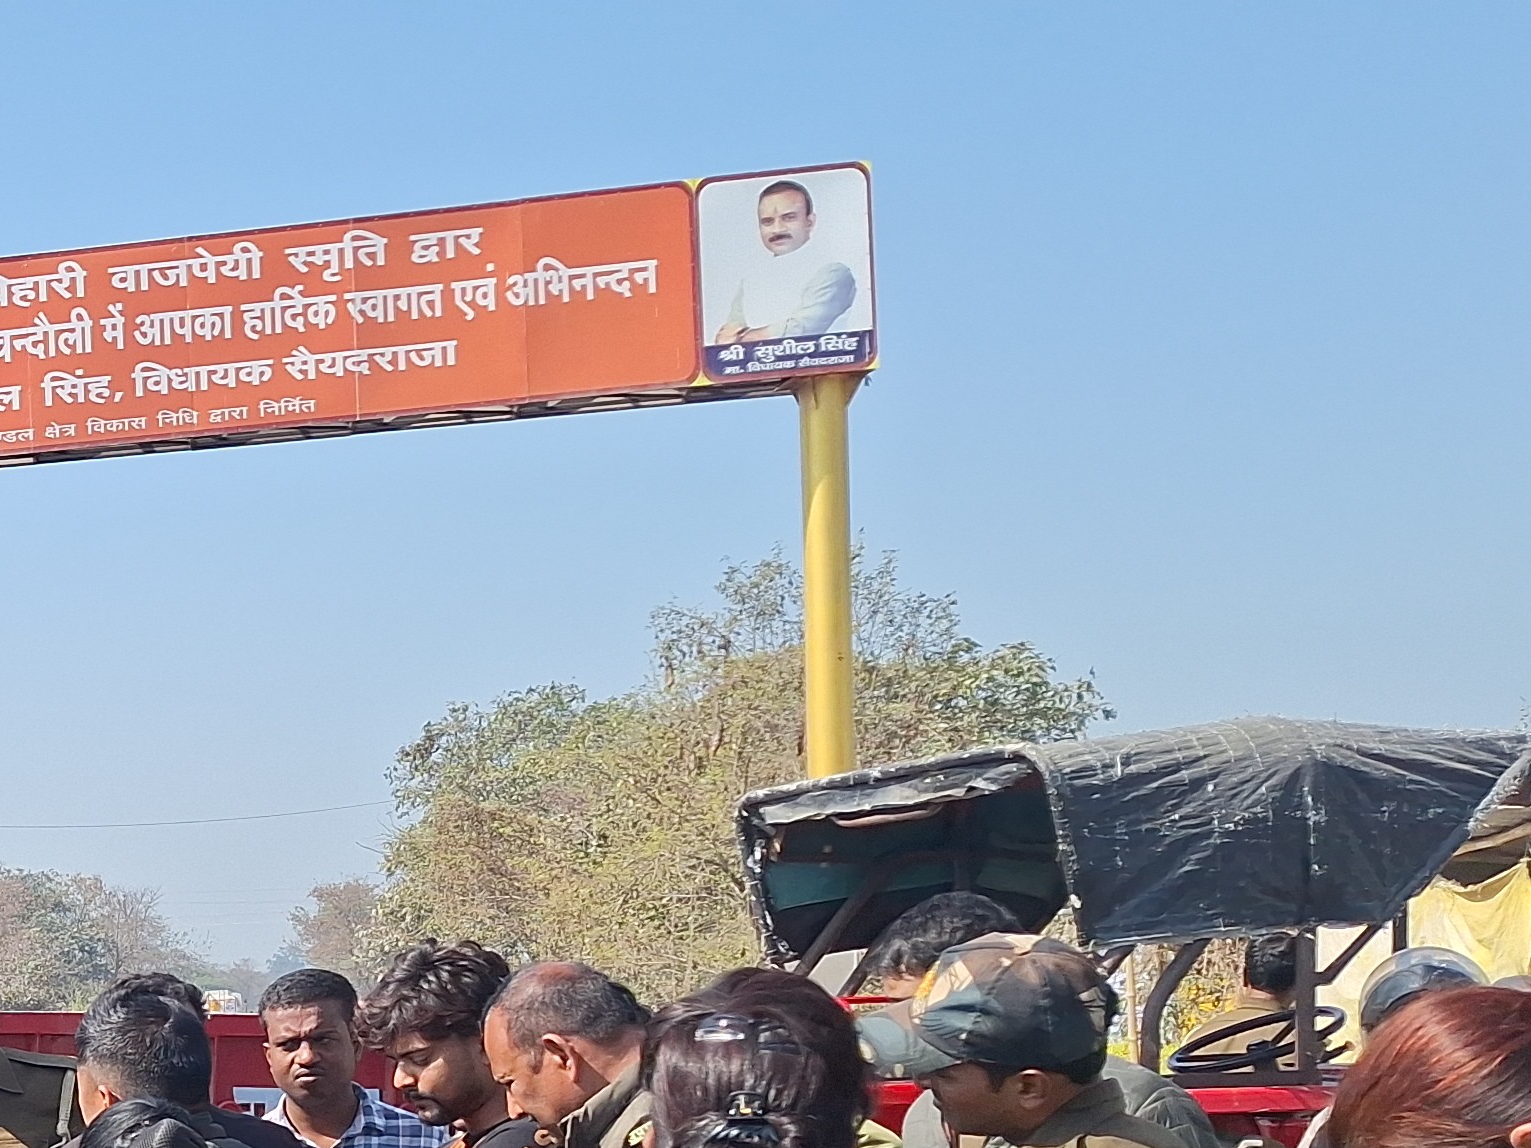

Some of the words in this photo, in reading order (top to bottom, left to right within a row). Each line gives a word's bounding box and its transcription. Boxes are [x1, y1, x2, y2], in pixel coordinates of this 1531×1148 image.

[107, 241, 264, 293] वाजपेयी
[285, 230, 388, 282] स्मृति
[409, 227, 484, 264] द्वार
[100, 302, 126, 350] में
[133, 305, 234, 347] आपका
[240, 284, 338, 341] हार्दिक
[343, 282, 443, 325] स्वागत
[450, 262, 498, 321] एवं
[505, 256, 659, 308] अभिनन्दन
[40, 368, 124, 408] सिंह,
[131, 361, 274, 398] विधायक
[281, 339, 459, 381] सैयदराजा
[718, 344, 746, 362] श्री
[755, 340, 817, 363] सुशील
[819, 333, 860, 352] सिंह
[747, 359, 797, 373] विधायक
[44, 421, 77, 440] क्षेत्र
[86, 415, 147, 435] विकास
[156, 409, 199, 429] निधि
[208, 405, 249, 423] द्वारा
[258, 395, 317, 418] निर्मित
